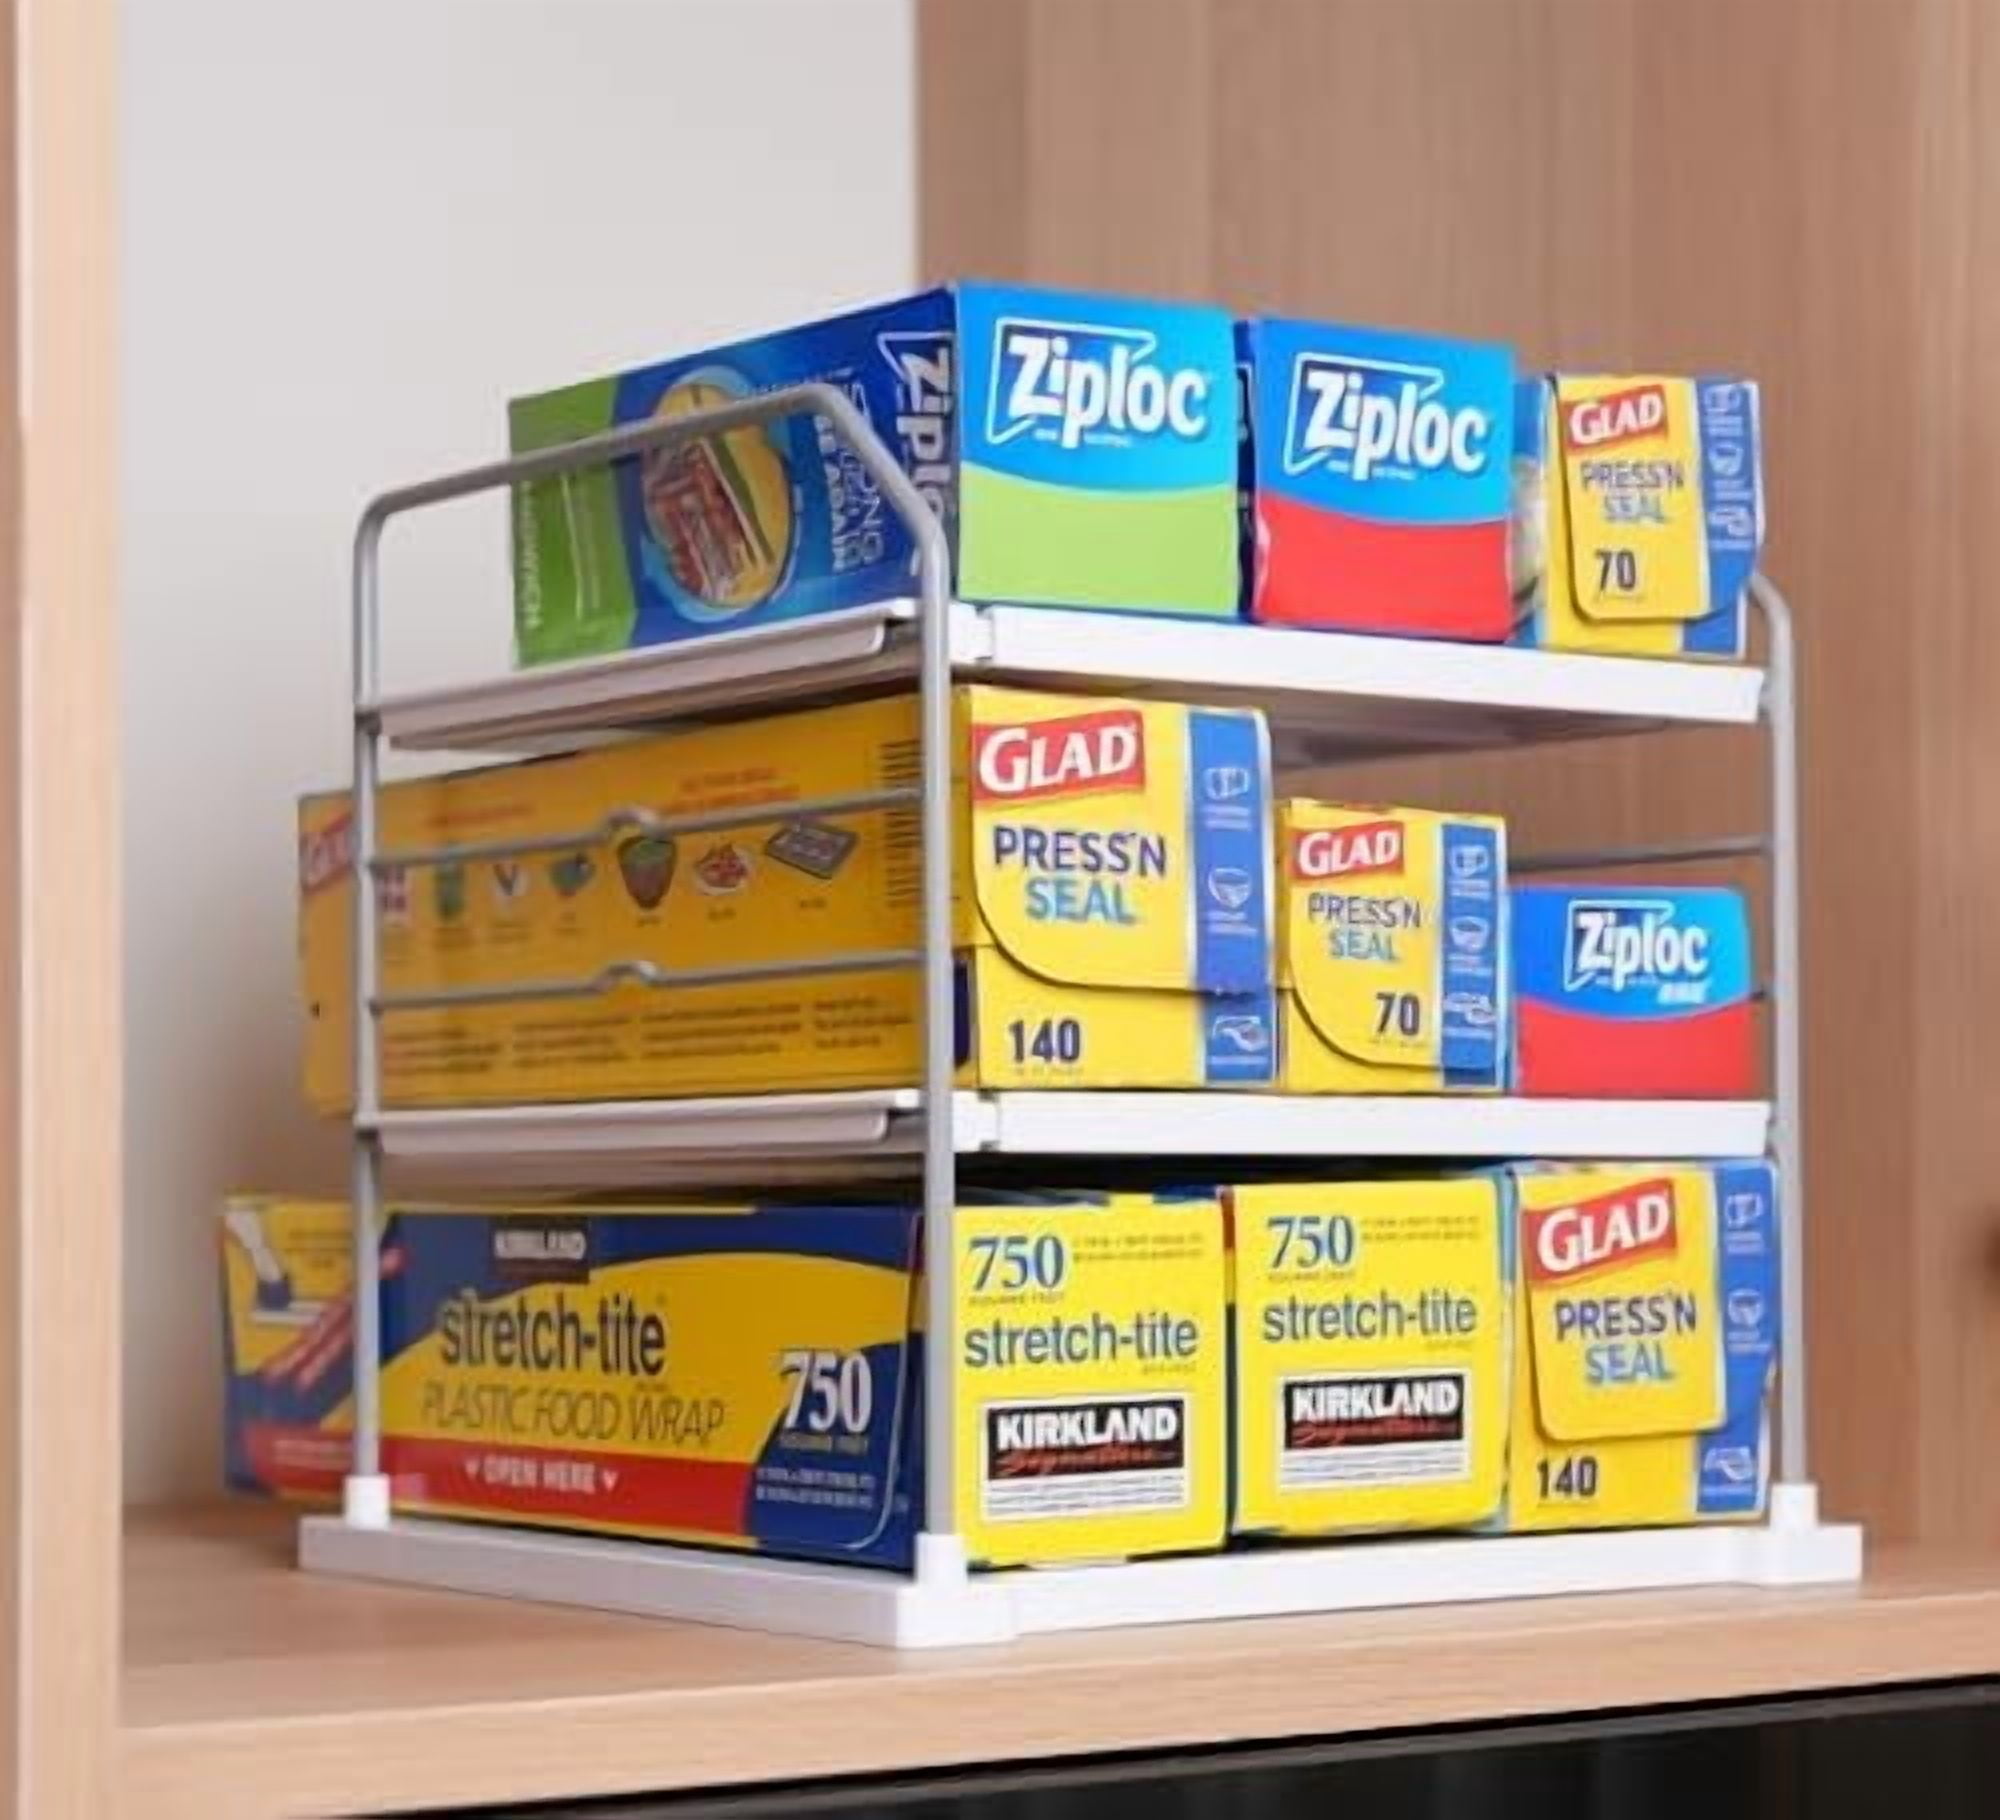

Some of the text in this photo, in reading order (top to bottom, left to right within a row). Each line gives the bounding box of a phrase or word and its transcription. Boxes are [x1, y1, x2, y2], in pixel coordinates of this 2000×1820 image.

[1008, 336, 1206, 448] Ziploc
[1570, 392, 1664, 445] GLAD
[1304, 371, 1488, 480] Ziploc
[1604, 495, 1665, 523] SEAL
[1595, 550, 1637, 592] 70
[979, 724, 1137, 793] GLAD
[1299, 829, 1399, 876] GLAD
[1025, 878, 1138, 925] SEAL
[1328, 927, 1399, 961] SEAL
[1577, 911, 1708, 991] Ziploc
[1375, 992, 1420, 1036] 70
[1008, 1020, 1082, 1063] 140
[1268, 1214, 1354, 1268] 750
[1537, 1191, 1671, 1273] GLAD
[968, 1234, 1064, 1292] 750
[441, 1294, 666, 1375] stretch-tite
[964, 1312, 1198, 1367] stretch-tite
[1264, 1288, 1477, 1342] stretch-tite
[1585, 1344, 1674, 1384] SEAL
[422, 1379, 726, 1448] PLASTIC FOOD WRAP
[779, 1351, 872, 1433] 750
[1292, 1380, 1460, 1423] KIRKLAND
[997, 1407, 1178, 1451] KIRKLAND
[1537, 1456, 1598, 1499] 140
